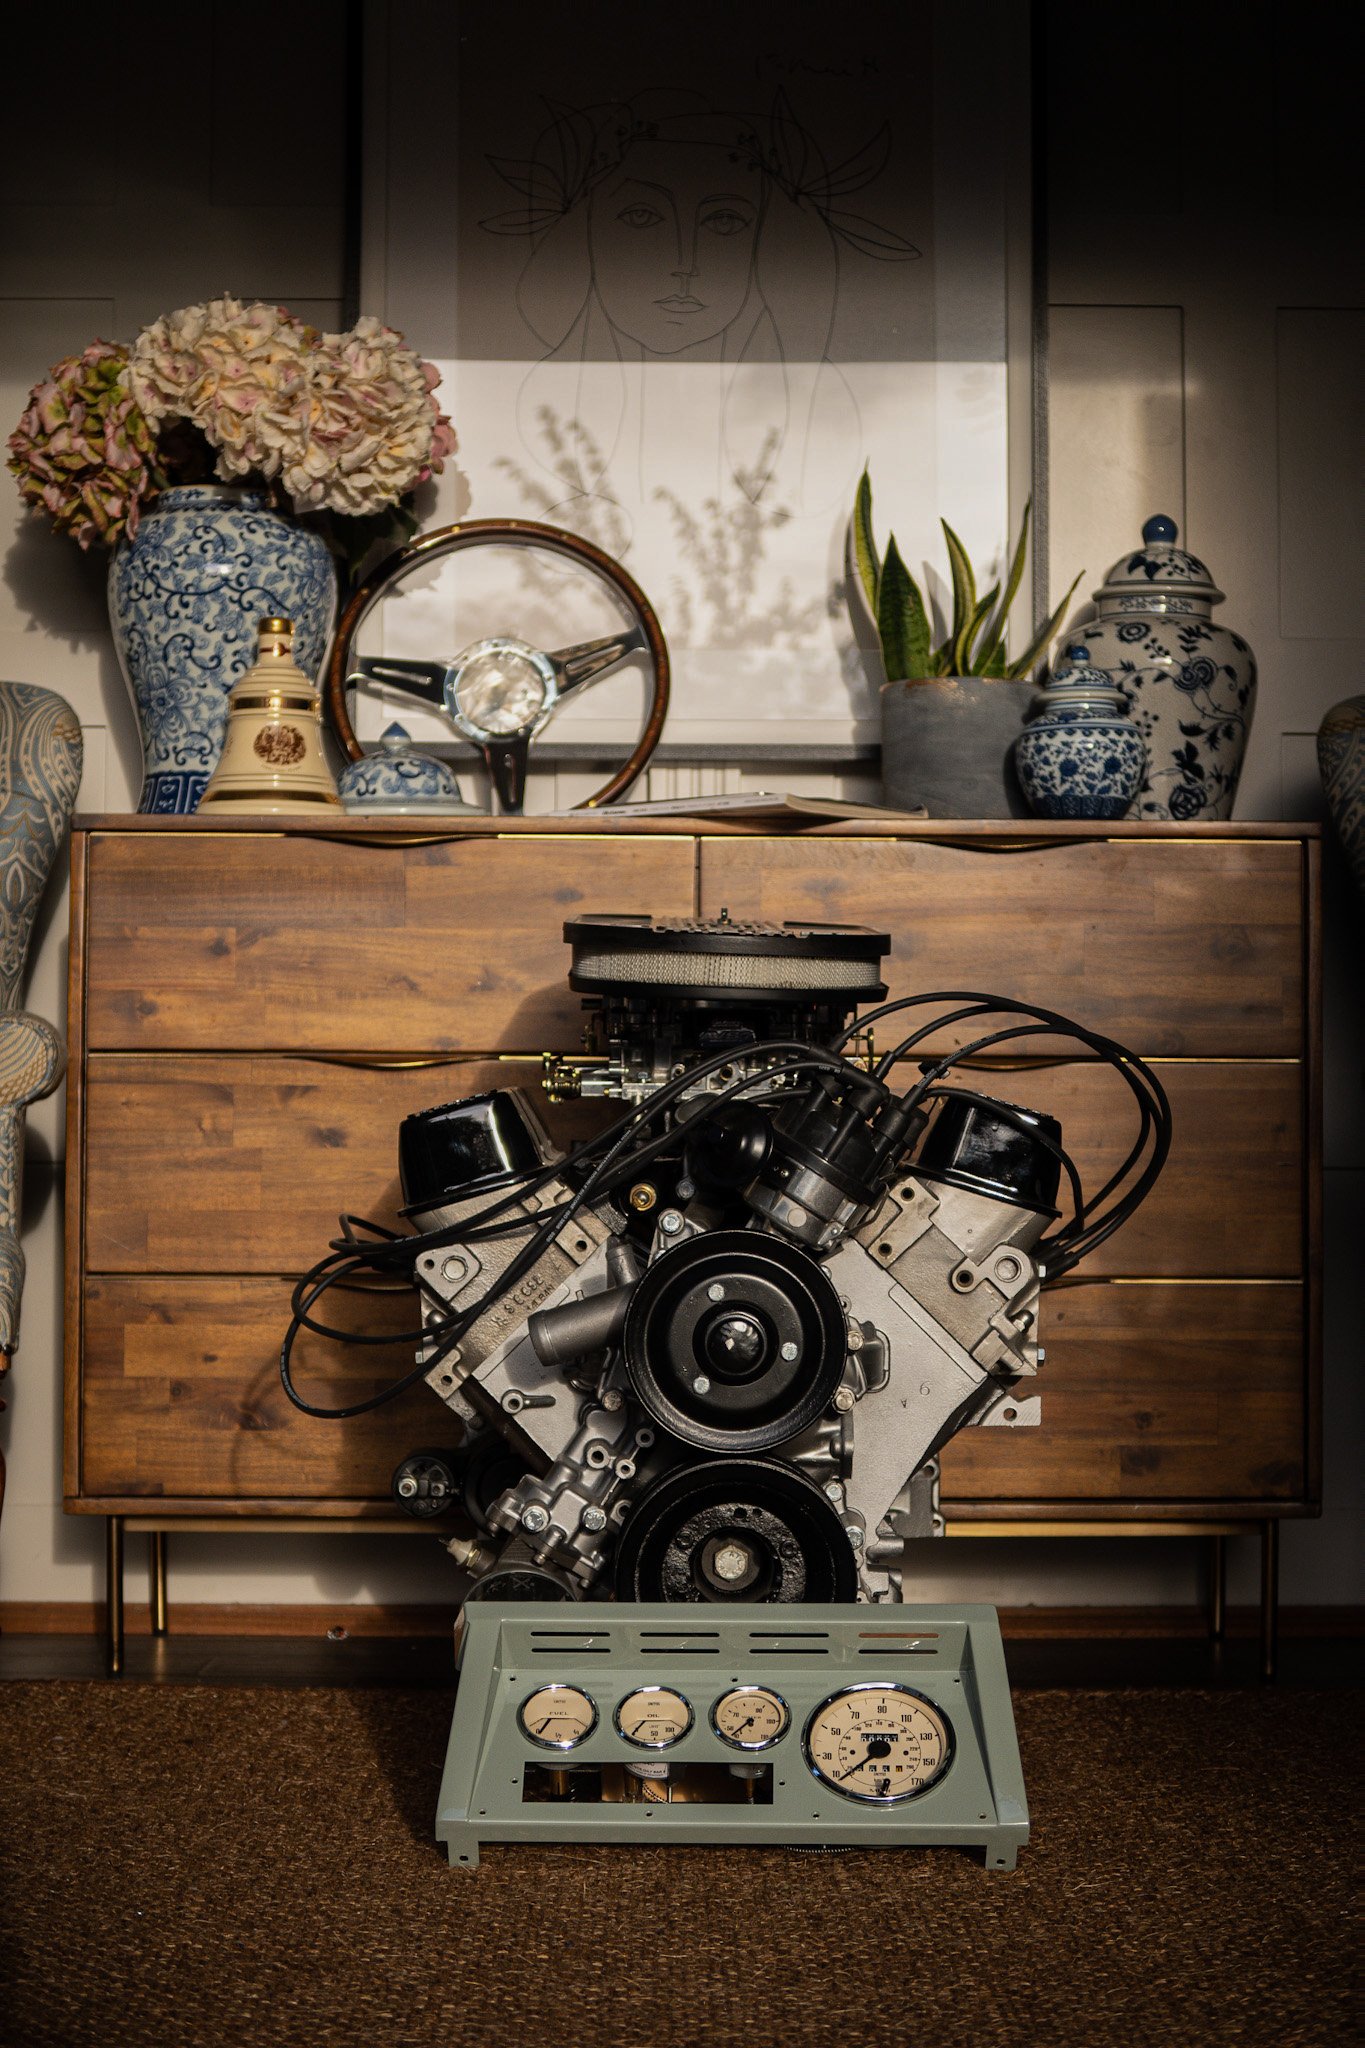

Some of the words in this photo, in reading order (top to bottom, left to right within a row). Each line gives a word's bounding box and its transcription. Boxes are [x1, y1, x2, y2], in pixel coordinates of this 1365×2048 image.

[877, 1706, 888, 1714] 90
[850, 1712, 860, 1720] 70
[901, 1714, 912, 1723] 110
[830, 1728, 841, 1736] 50
[920, 1732, 933, 1741] 130
[822, 1752, 832, 1761] 30
[922, 1758, 935, 1766] 150
[832, 1770, 841, 1778] 10
[911, 1777, 924, 1786] 170
